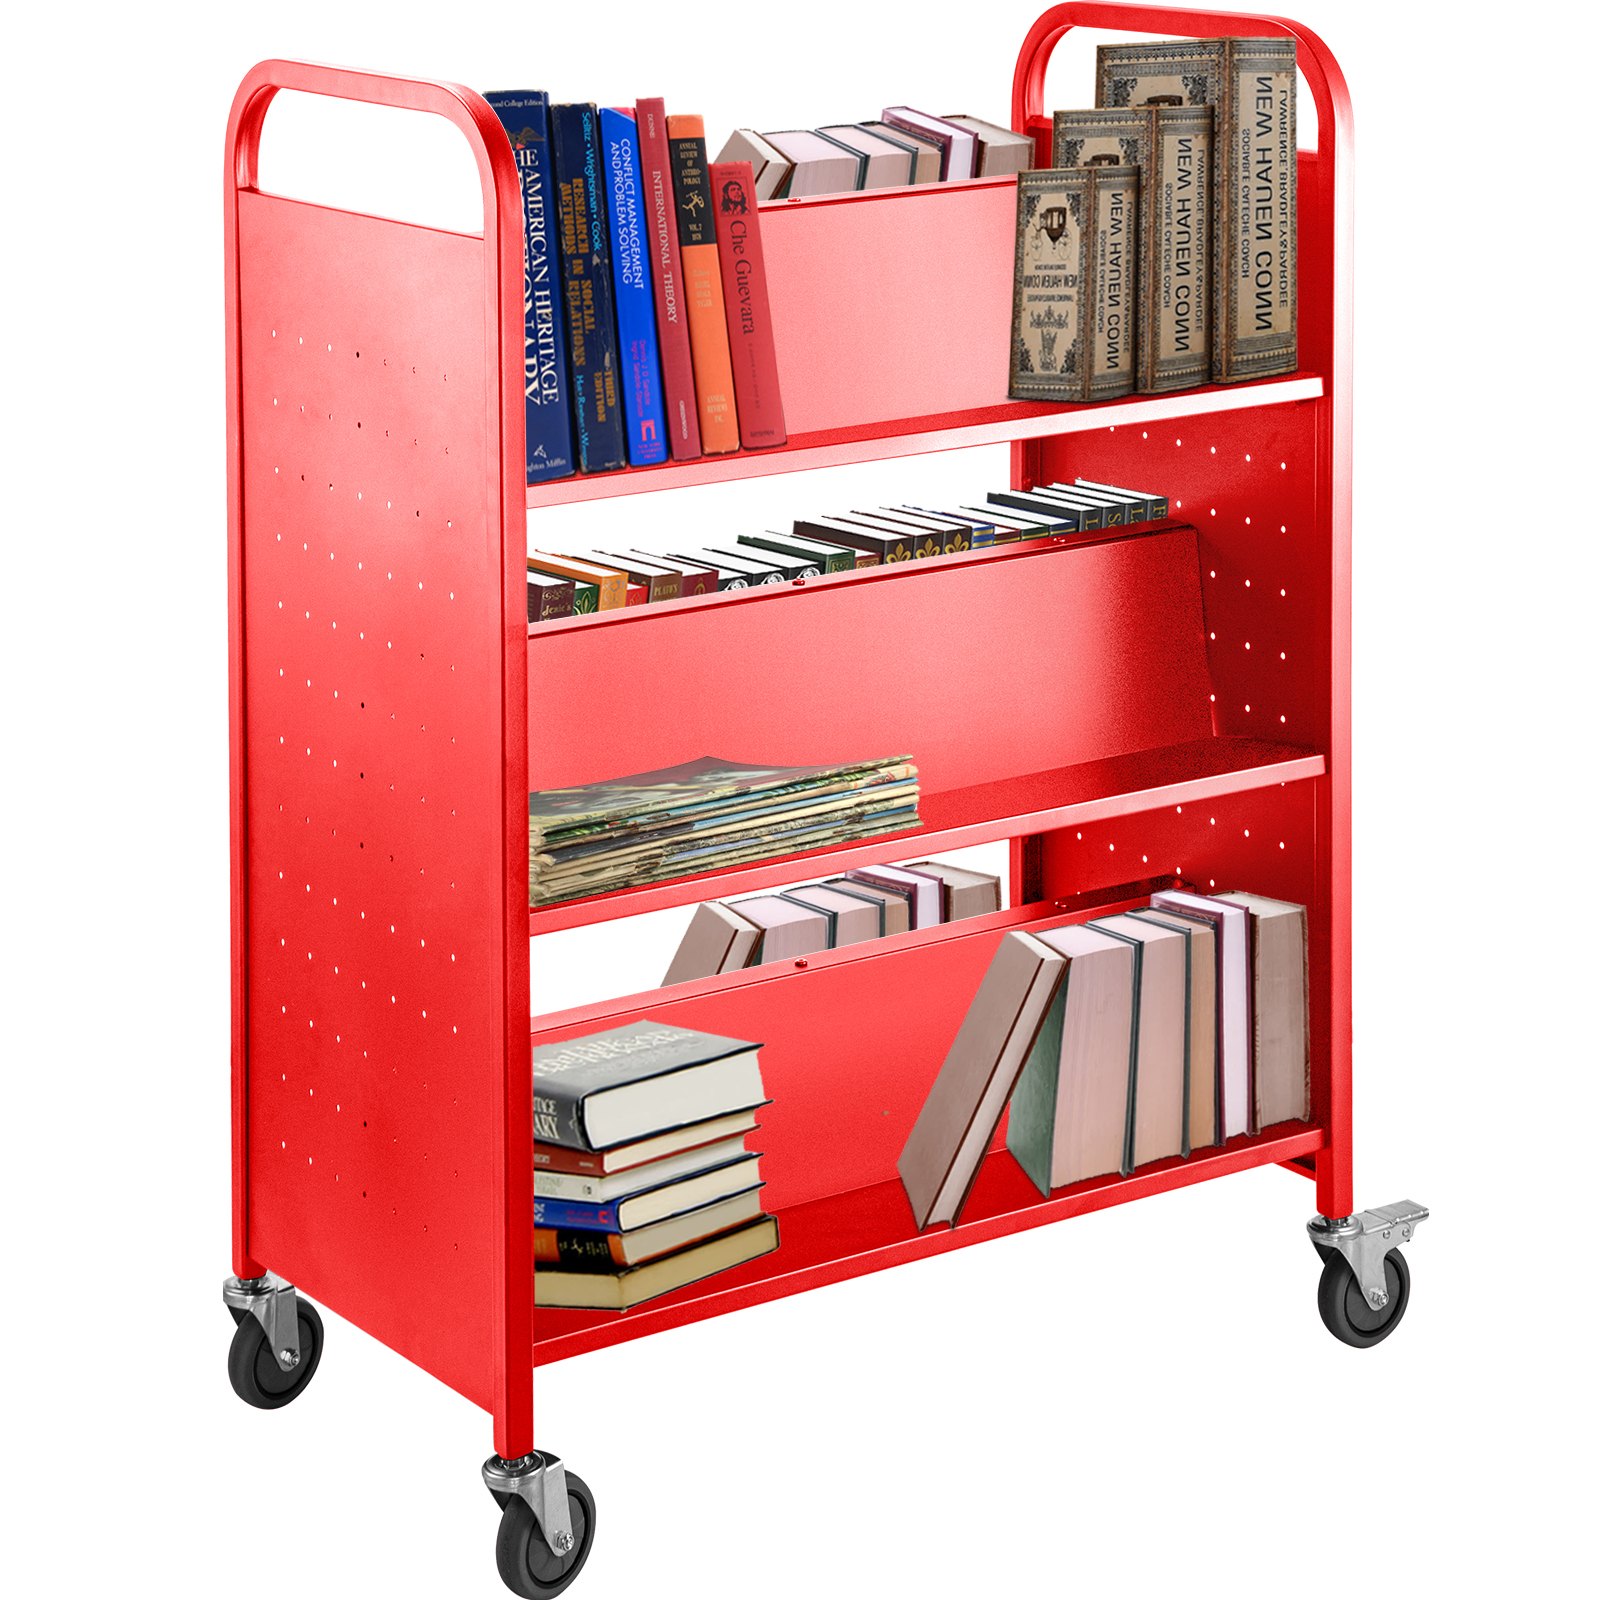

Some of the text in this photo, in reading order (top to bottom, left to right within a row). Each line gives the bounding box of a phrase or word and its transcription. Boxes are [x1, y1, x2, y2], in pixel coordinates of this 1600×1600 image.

[513, 149, 539, 167] HE
[584, 148, 598, 213] Wrightsman
[525, 169, 549, 283] AMERICAN
[590, 220, 602, 251] Cook
[620, 138, 644, 290] CONFLICT MANAGEMENT
[652, 171, 678, 324] INTERNATIONAL THEORY
[730, 220, 747, 256] Che
[560, 183, 586, 366] METHODS RELATIONS
[572, 178, 596, 335] RESEARCH IN SOCIAL
[618, 227, 633, 284] SOLVING
[735, 258, 756, 335] Guevara
[534, 289, 559, 405] HERITAGE
[593, 371, 607, 422] EDITION
[604, 369, 616, 408] THIRD
